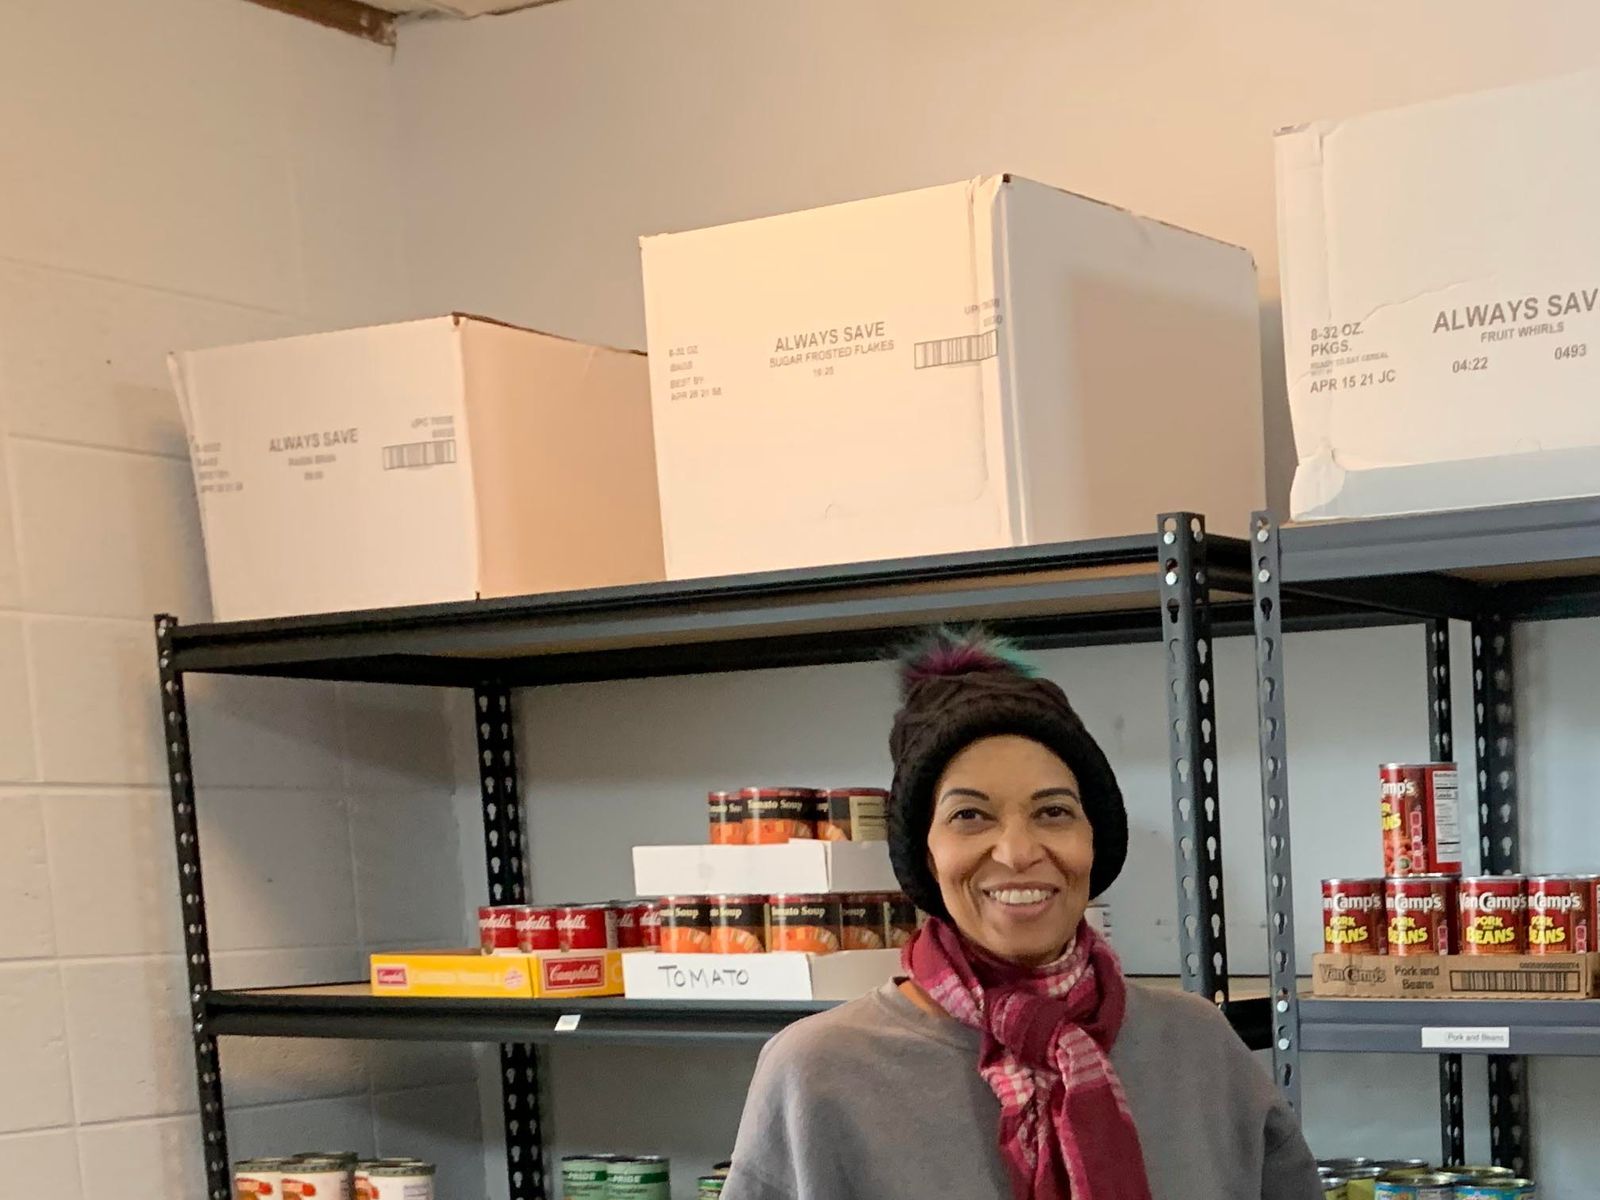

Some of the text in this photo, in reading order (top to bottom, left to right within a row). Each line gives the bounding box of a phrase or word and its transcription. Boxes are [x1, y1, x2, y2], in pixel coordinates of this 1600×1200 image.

[1432, 297, 1539, 334] ALWAYS
[774, 322, 885, 353] ALWAYS SAVE
[1311, 326, 1338, 341] 8-32
[1481, 321, 1564, 343] FRUIT WHIRLS
[769, 340, 895, 368] SUGAR FROSTED FLAKES
[1311, 341, 1352, 356] PKGS.
[1554, 344, 1587, 360] 0493
[1452, 357, 1488, 374] 04:22
[1310, 369, 1396, 393] APR 15 21 JC
[269, 428, 358, 452] ALWAYS SAVE
[748, 799, 803, 812] Tomato Soup
[675, 907, 699, 919] Soup
[719, 907, 742, 919] Soup
[801, 907, 826, 919] Soup
[1330, 917, 1355, 928] PORK
[1392, 917, 1415, 927] PORK
[1477, 917, 1503, 927] PORK
[1325, 927, 1368, 943] BEANS
[1388, 927, 1427, 944] BEANS
[1466, 927, 1515, 944] BEANS
[658, 964, 749, 988] TOMATO
[1395, 966, 1439, 978] Pork and
[1403, 979, 1434, 989] Beans
